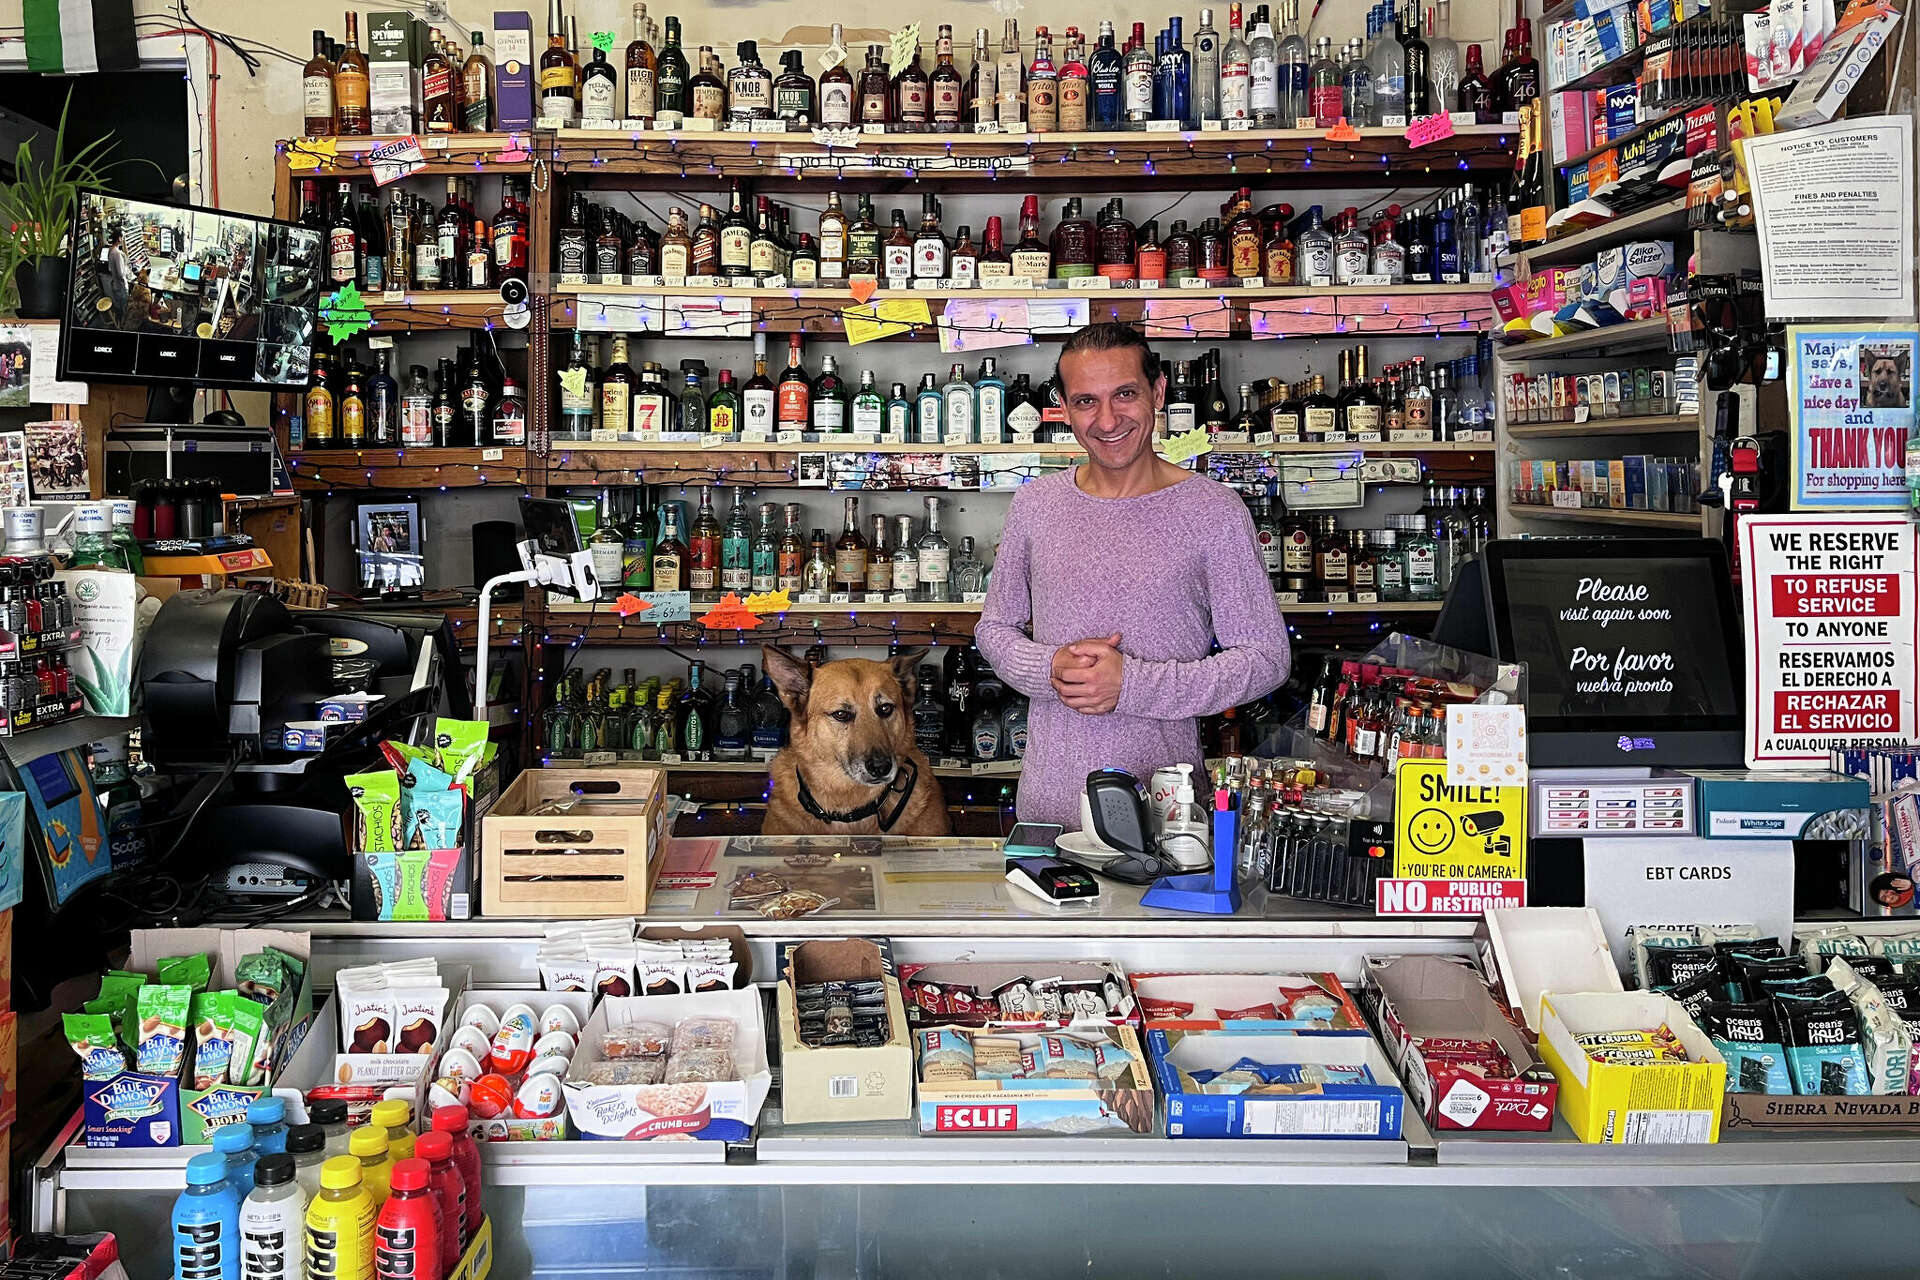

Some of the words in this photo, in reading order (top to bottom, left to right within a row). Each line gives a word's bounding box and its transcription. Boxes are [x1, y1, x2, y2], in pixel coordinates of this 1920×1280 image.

[1777, 1, 1794, 13] VISINE
[371, 29, 404, 40] SPEYBURN
[1645, 38, 1672, 55] DURACELL
[1160, 53, 1183, 66] SKYY
[735, 81, 761, 93] KNOB
[1514, 86, 1536, 99] 46
[779, 91, 800, 101] KNOB
[1780, 143, 1812, 153] NOTICE
[1828, 134, 1879, 145] CUSTOMERS
[1621, 139, 1646, 163] Advil
[801, 157, 820, 168] NO
[871, 157, 893, 168] NO
[897, 157, 933, 169] SALE
[958, 157, 1012, 169] PERIOD
[1794, 191, 1818, 200] FINES
[1820, 191, 1837, 199] AND
[1838, 190, 1878, 198] PENALTIES
[1233, 233, 1259, 246] FIREBALL
[1629, 252, 1663, 266] Seltzer
[1809, 375, 1841, 389] Have
[1844, 378, 1853, 389] a
[1804, 395, 1832, 409] nice
[1834, 395, 1860, 412] day
[639, 404, 657, 430] 7
[1844, 411, 1874, 425] and
[1808, 428, 1870, 469] THANK
[1872, 426, 1908, 469] YOU
[1806, 474, 1825, 487] For
[1827, 474, 1879, 490] shopping
[1882, 474, 1906, 486] here
[1769, 533, 1802, 551] WE
[1809, 532, 1899, 551] RESERVE
[1786, 555, 1821, 570] THE
[1829, 555, 1884, 570] RIGHT
[1575, 577, 1650, 602] Please
[1784, 579, 1808, 594] TO
[1815, 578, 1888, 593] REFUSE
[1797, 597, 1876, 613] SERVICE
[1559, 606, 1590, 621] visit
[1592, 606, 1636, 629] again
[1638, 609, 1672, 620] soon
[1786, 622, 1809, 637] TO
[1816, 622, 1888, 637] ANYONE
[41, 632, 66, 642] EXTRA
[1569, 646, 1610, 671] Por
[1613, 646, 1675, 681] favor
[1779, 651, 1895, 669] RESERVAMOS
[1576, 676, 1623, 693] vuelva
[1625, 677, 1674, 696] pronto
[1782, 672, 1800, 687] EL
[1804, 671, 1878, 687] DERECHO
[1881, 671, 1892, 686] A
[36, 703, 65, 714] EXTRA
[1787, 695, 1886, 710] RECHAZAR
[36, 711, 66, 722] STRENGTH
[1780, 714, 1802, 729] EL
[1809, 713, 1893, 729] SERVICIO
[1764, 740, 1773, 751] A
[1775, 738, 1848, 751] CUALQUIER
[1851, 737, 1908, 749] PERSONA
[1419, 773, 1500, 803] SMILE!
[1765, 820, 1782, 828] Sage
[1407, 864, 1446, 877] YOU'RE
[1449, 864, 1464, 877] ON
[1467, 864, 1512, 879] CAMERA
[1646, 867, 1675, 880] EBT
[1679, 867, 1732, 880] CARDS
[1450, 881, 1503, 896] PUBLIC
[1383, 881, 1427, 913] NO
[1431, 897, 1520, 912] RESTROOM
[645, 965, 676, 976] Justin's
[696, 968, 726, 977] Justin's
[554, 973, 585, 984] Justin's
[354, 1004, 389, 1016] Justin's
[402, 1004, 436, 1016] Justin's
[1725, 1017, 1762, 1027] ocean's
[1807, 1020, 1843, 1029] ocean's
[1599, 1033, 1643, 1045] CRUNCH
[1726, 1025, 1765, 1042] HALO
[1808, 1028, 1844, 1044] HALO
[145, 1038, 175, 1050] BLUE
[1431, 1038, 1472, 1049] Dark
[1735, 1043, 1748, 1051] Sea
[1815, 1046, 1829, 1055] Sea
[1609, 1048, 1655, 1060] CRUNCH
[357, 1066, 380, 1076] PEANUT
[382, 1066, 404, 1076] BUTTER
[405, 1065, 422, 1076] CUPS
[1886, 1048, 1907, 1092] NORI
[99, 1085, 160, 1106] DIAMOND
[112, 1082, 142, 1095] BLUE
[197, 1094, 253, 1114] DIAMOND
[208, 1091, 237, 1104] BLUE
[713, 1100, 723, 1114] 12
[1495, 1101, 1532, 1117] Dark
[1766, 1102, 1827, 1115] SIERRA
[1834, 1102, 1901, 1115] NEVADA
[210, 1113, 247, 1127] BOLD
[648, 1119, 683, 1132] CRUMB
[943, 1109, 952, 1128] BAR
[954, 1109, 1013, 1128] CLIF
[87, 1125, 105, 1133] Smart
